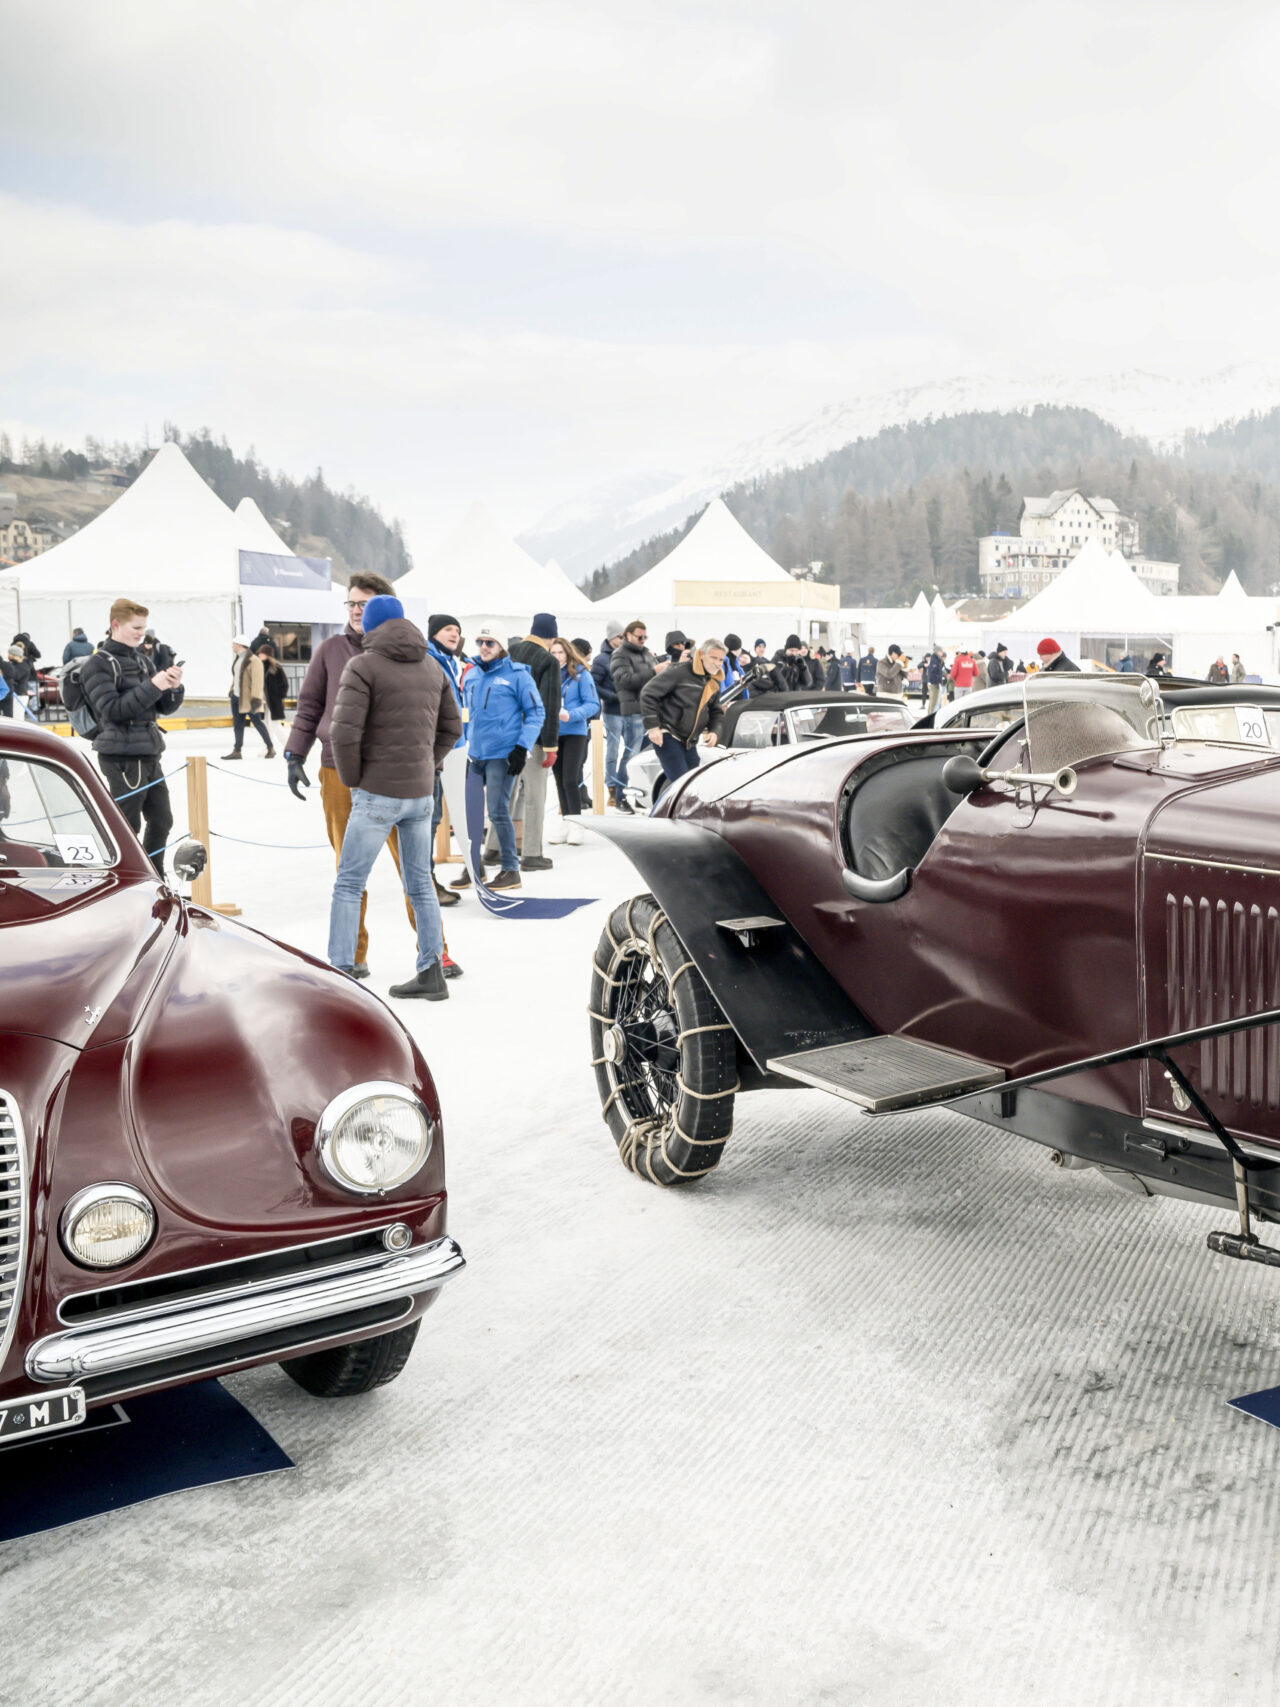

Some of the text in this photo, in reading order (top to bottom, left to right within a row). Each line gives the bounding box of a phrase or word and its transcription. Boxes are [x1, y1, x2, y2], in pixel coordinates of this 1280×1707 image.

[714, 590, 762, 598] RESTAURANT
[1242, 722, 1262, 739] 20
[67, 846, 95, 861] 23
